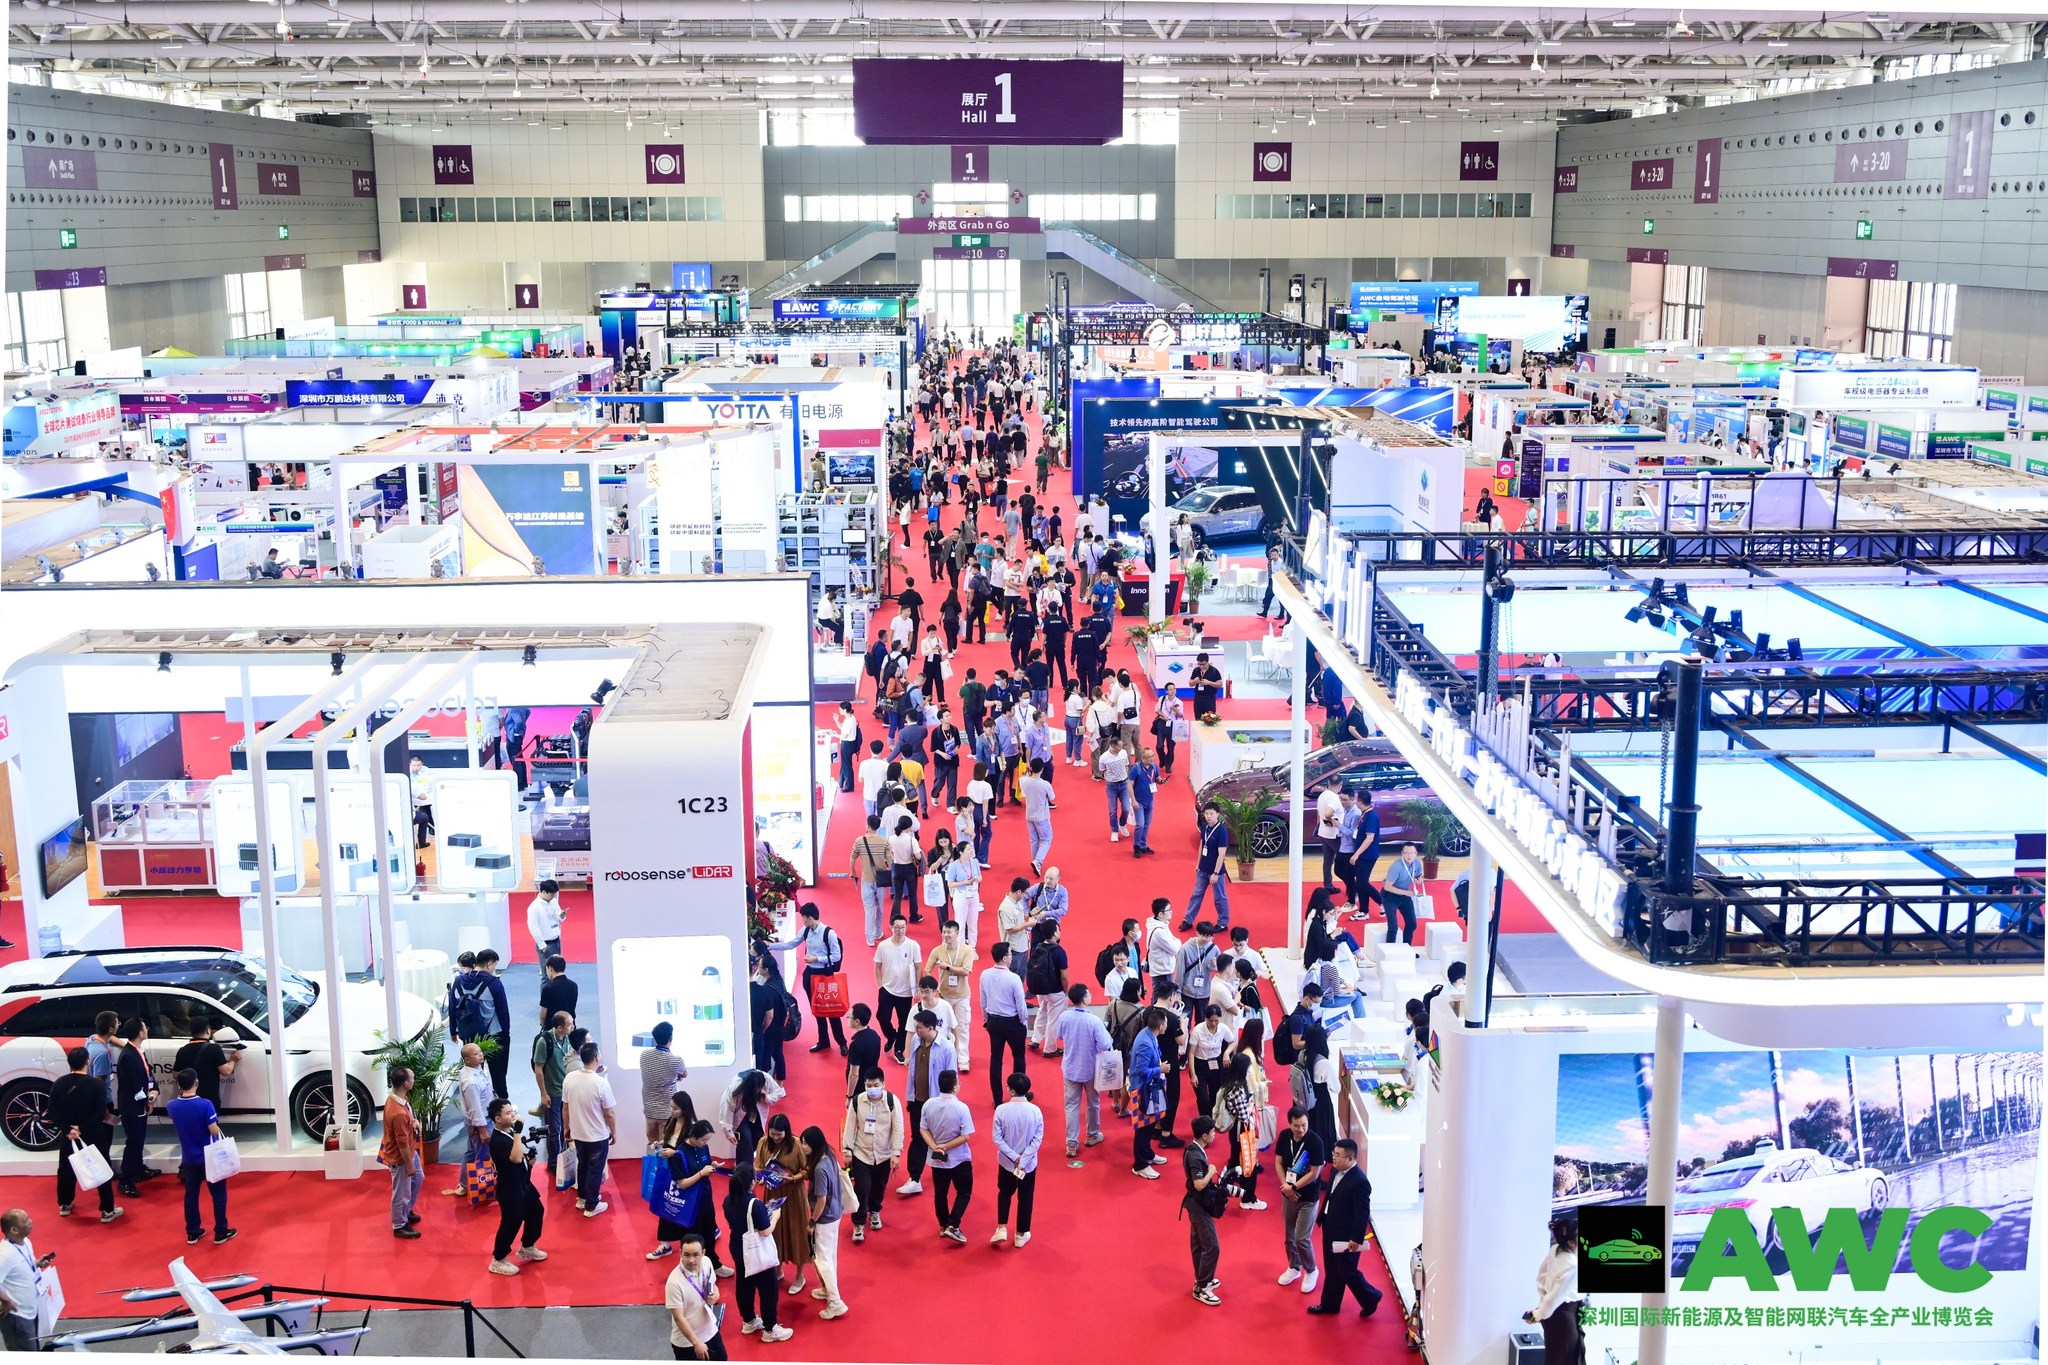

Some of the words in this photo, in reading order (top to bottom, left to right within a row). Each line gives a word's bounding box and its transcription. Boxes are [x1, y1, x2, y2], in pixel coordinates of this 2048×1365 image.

[961, 93, 988, 107] 展厅
[994, 72, 1017, 123] 1
[961, 110, 988, 123] Hall
[1963, 130, 1975, 177] 1
[965, 152, 975, 174] 1
[1870, 151, 1891, 172] 3-20
[219, 157, 228, 193] 1
[1703, 153, 1711, 187] 1
[928, 220, 957, 231] 外卖区
[959, 220, 984, 230] Grab
[986, 221, 993, 230] n
[995, 220, 1010, 230] Go
[971, 249, 983, 259] 10
[72, 271, 80, 286] 13
[791, 302, 820, 312] AWC
[298, 394, 405, 404] 深圳市万鹏达科技有限公司
[1844, 387, 1930, 396] 车规级电感器专业制造商
[706, 403, 771, 419] YOTTA
[1109, 418, 1219, 427] 技术领先的高阶智能驾驶公司
[677, 796, 729, 814] 1C23
[604, 869, 687, 881] robosense
[693, 866, 731, 878] LiDAR
[816, 992, 839, 1000] AGV
